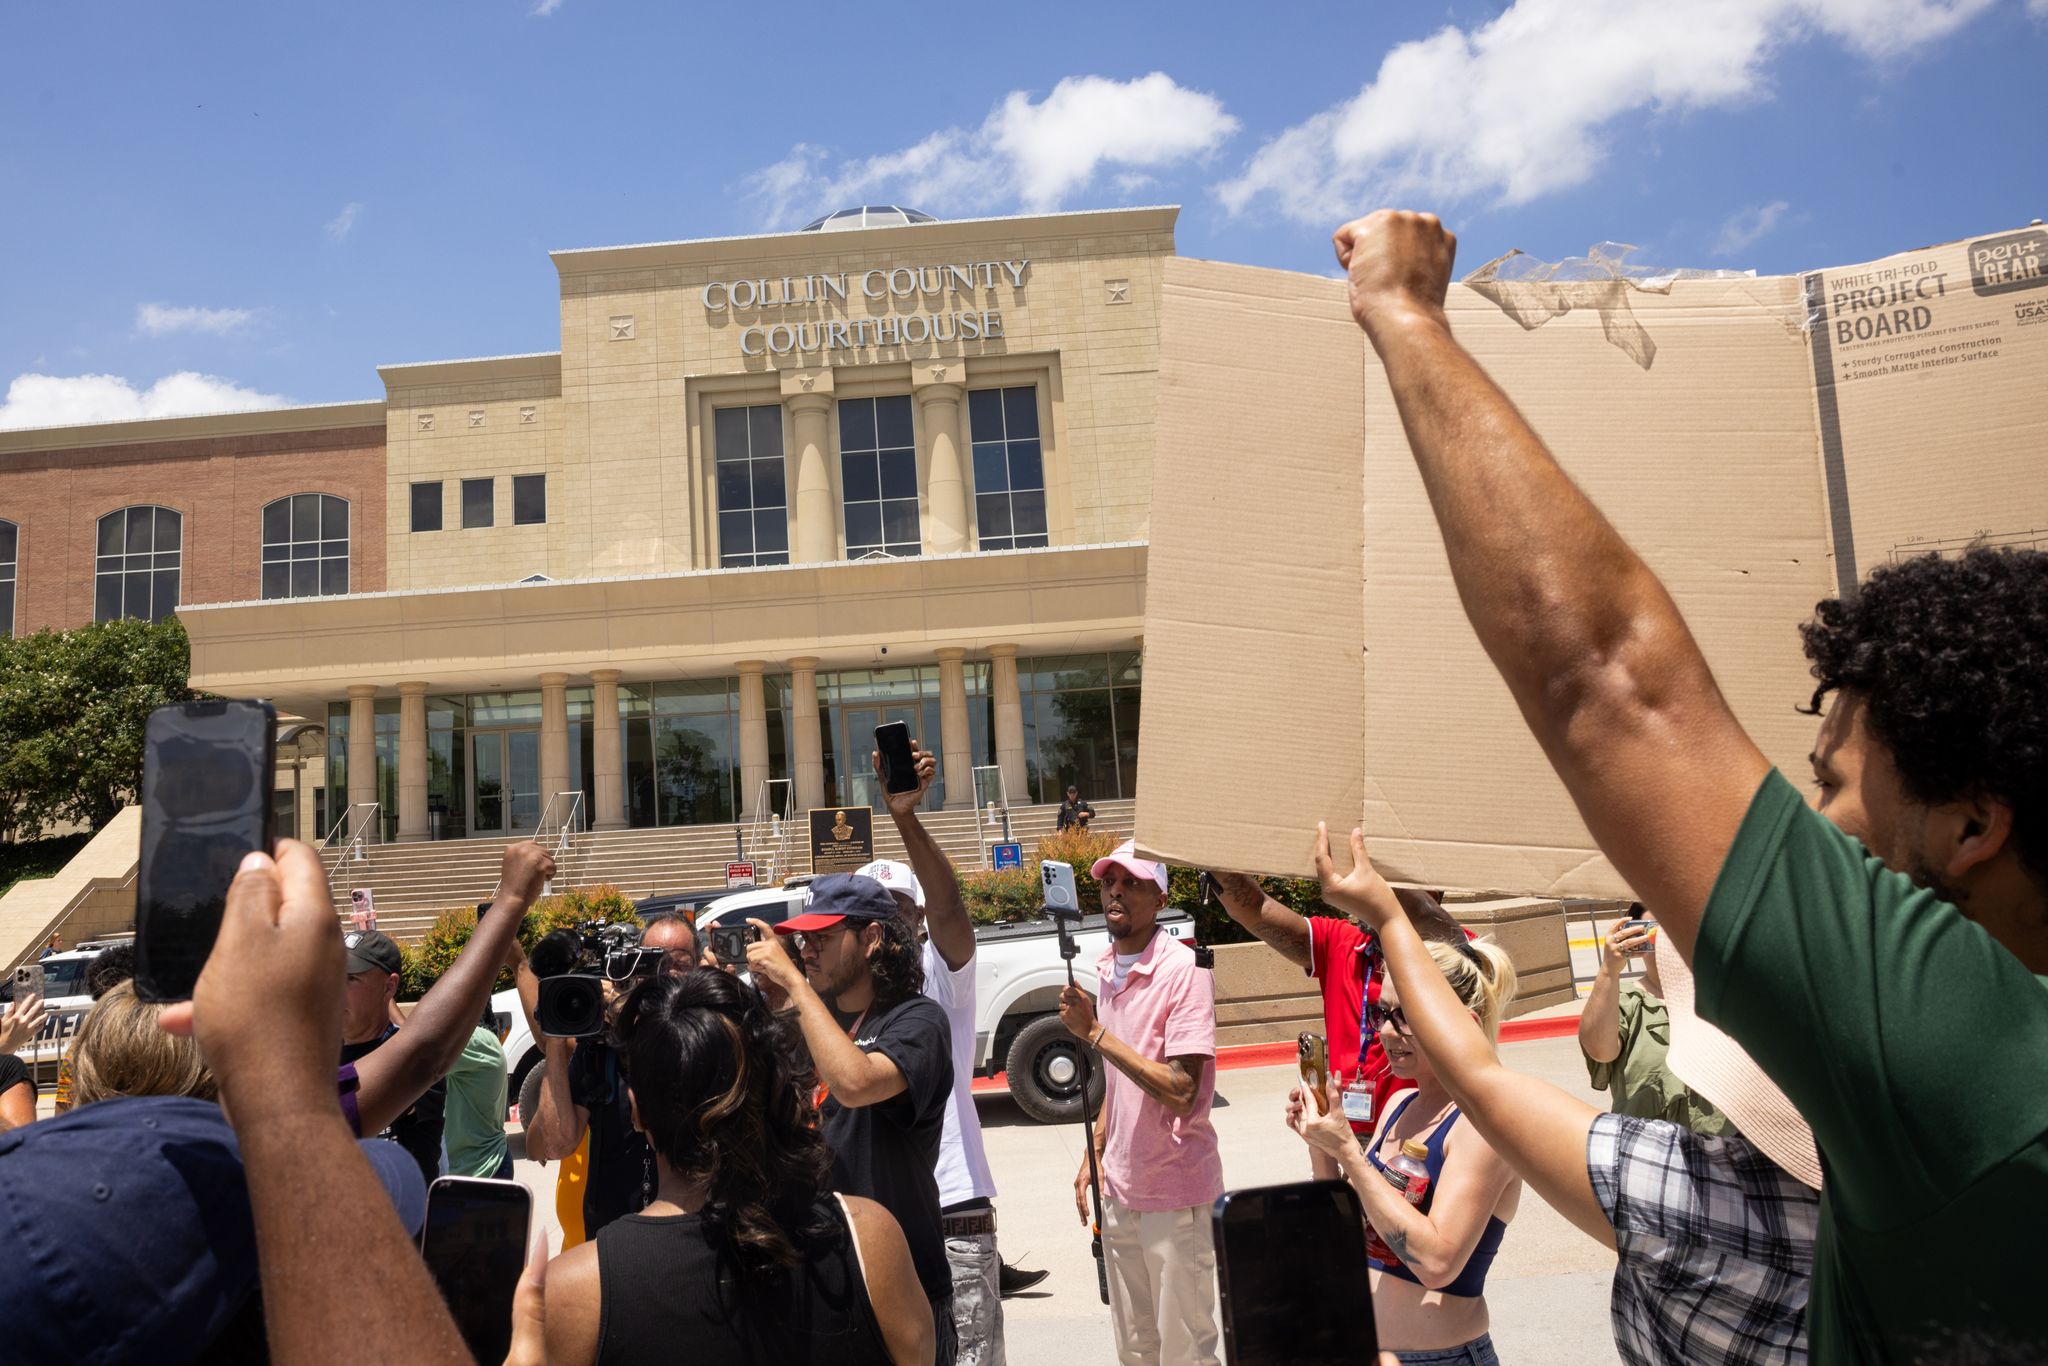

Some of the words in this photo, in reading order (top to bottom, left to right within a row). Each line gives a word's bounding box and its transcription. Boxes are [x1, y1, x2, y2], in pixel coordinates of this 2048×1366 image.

[703, 272, 849, 311] COLLIN
[861, 259, 1031, 299] COUNTY
[1831, 273, 1873, 291] WHITE
[1877, 260, 1938, 281] TRI-FOLD
[1983, 255, 2041, 286] GEAR
[1833, 273, 1949, 317] PROJECT
[1836, 305, 1932, 345] BOARD
[2015, 306, 2046, 319] USA
[738, 310, 1006, 356] COURTHOUSE
[1851, 355, 1882, 368] Sturdy
[1884, 346, 1937, 363] Corrugated
[1939, 336, 2002, 353] Construction
[1853, 367, 1889, 380] Smooth
[1891, 363, 1919, 374] Matte
[1921, 356, 1959, 369] Interior
[1960, 349, 1999, 362] Surface
